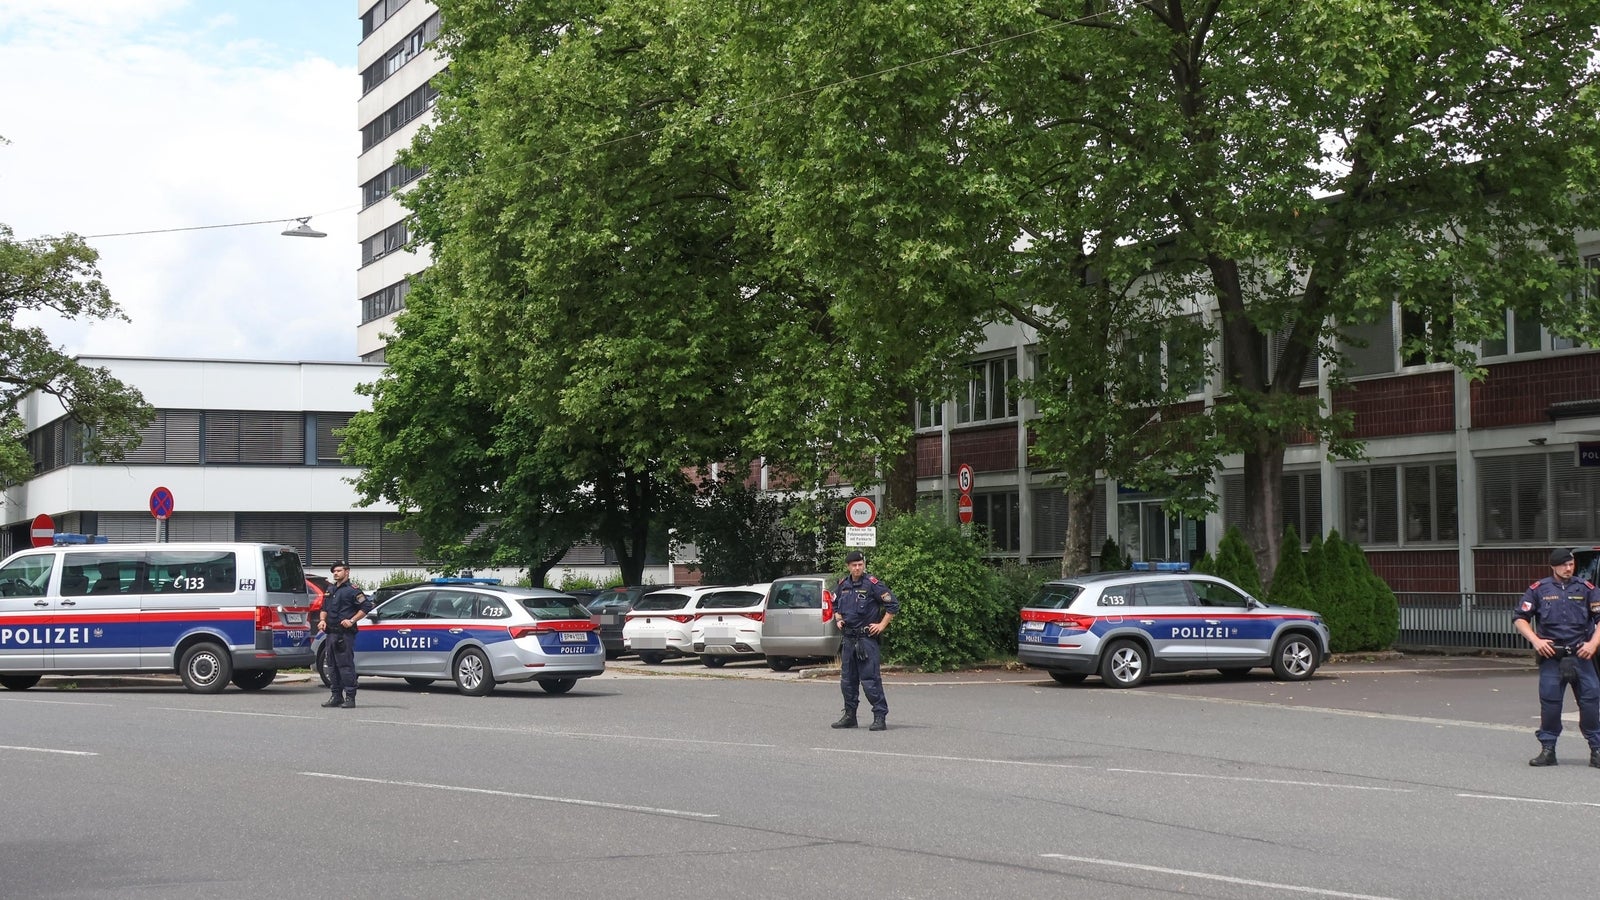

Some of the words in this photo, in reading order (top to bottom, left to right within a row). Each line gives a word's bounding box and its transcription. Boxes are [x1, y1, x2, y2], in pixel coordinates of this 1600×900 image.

[961, 471, 969, 488] 15
[183, 577, 205, 590] 133
[1108, 595, 1125, 605] 133
[489, 607, 504, 617] 133
[1, 628, 89, 644] POLIZEI
[1171, 627, 1229, 638] POLIZEI
[383, 637, 431, 649] POLIZEI
[560, 646, 586, 654] POLIZEI
